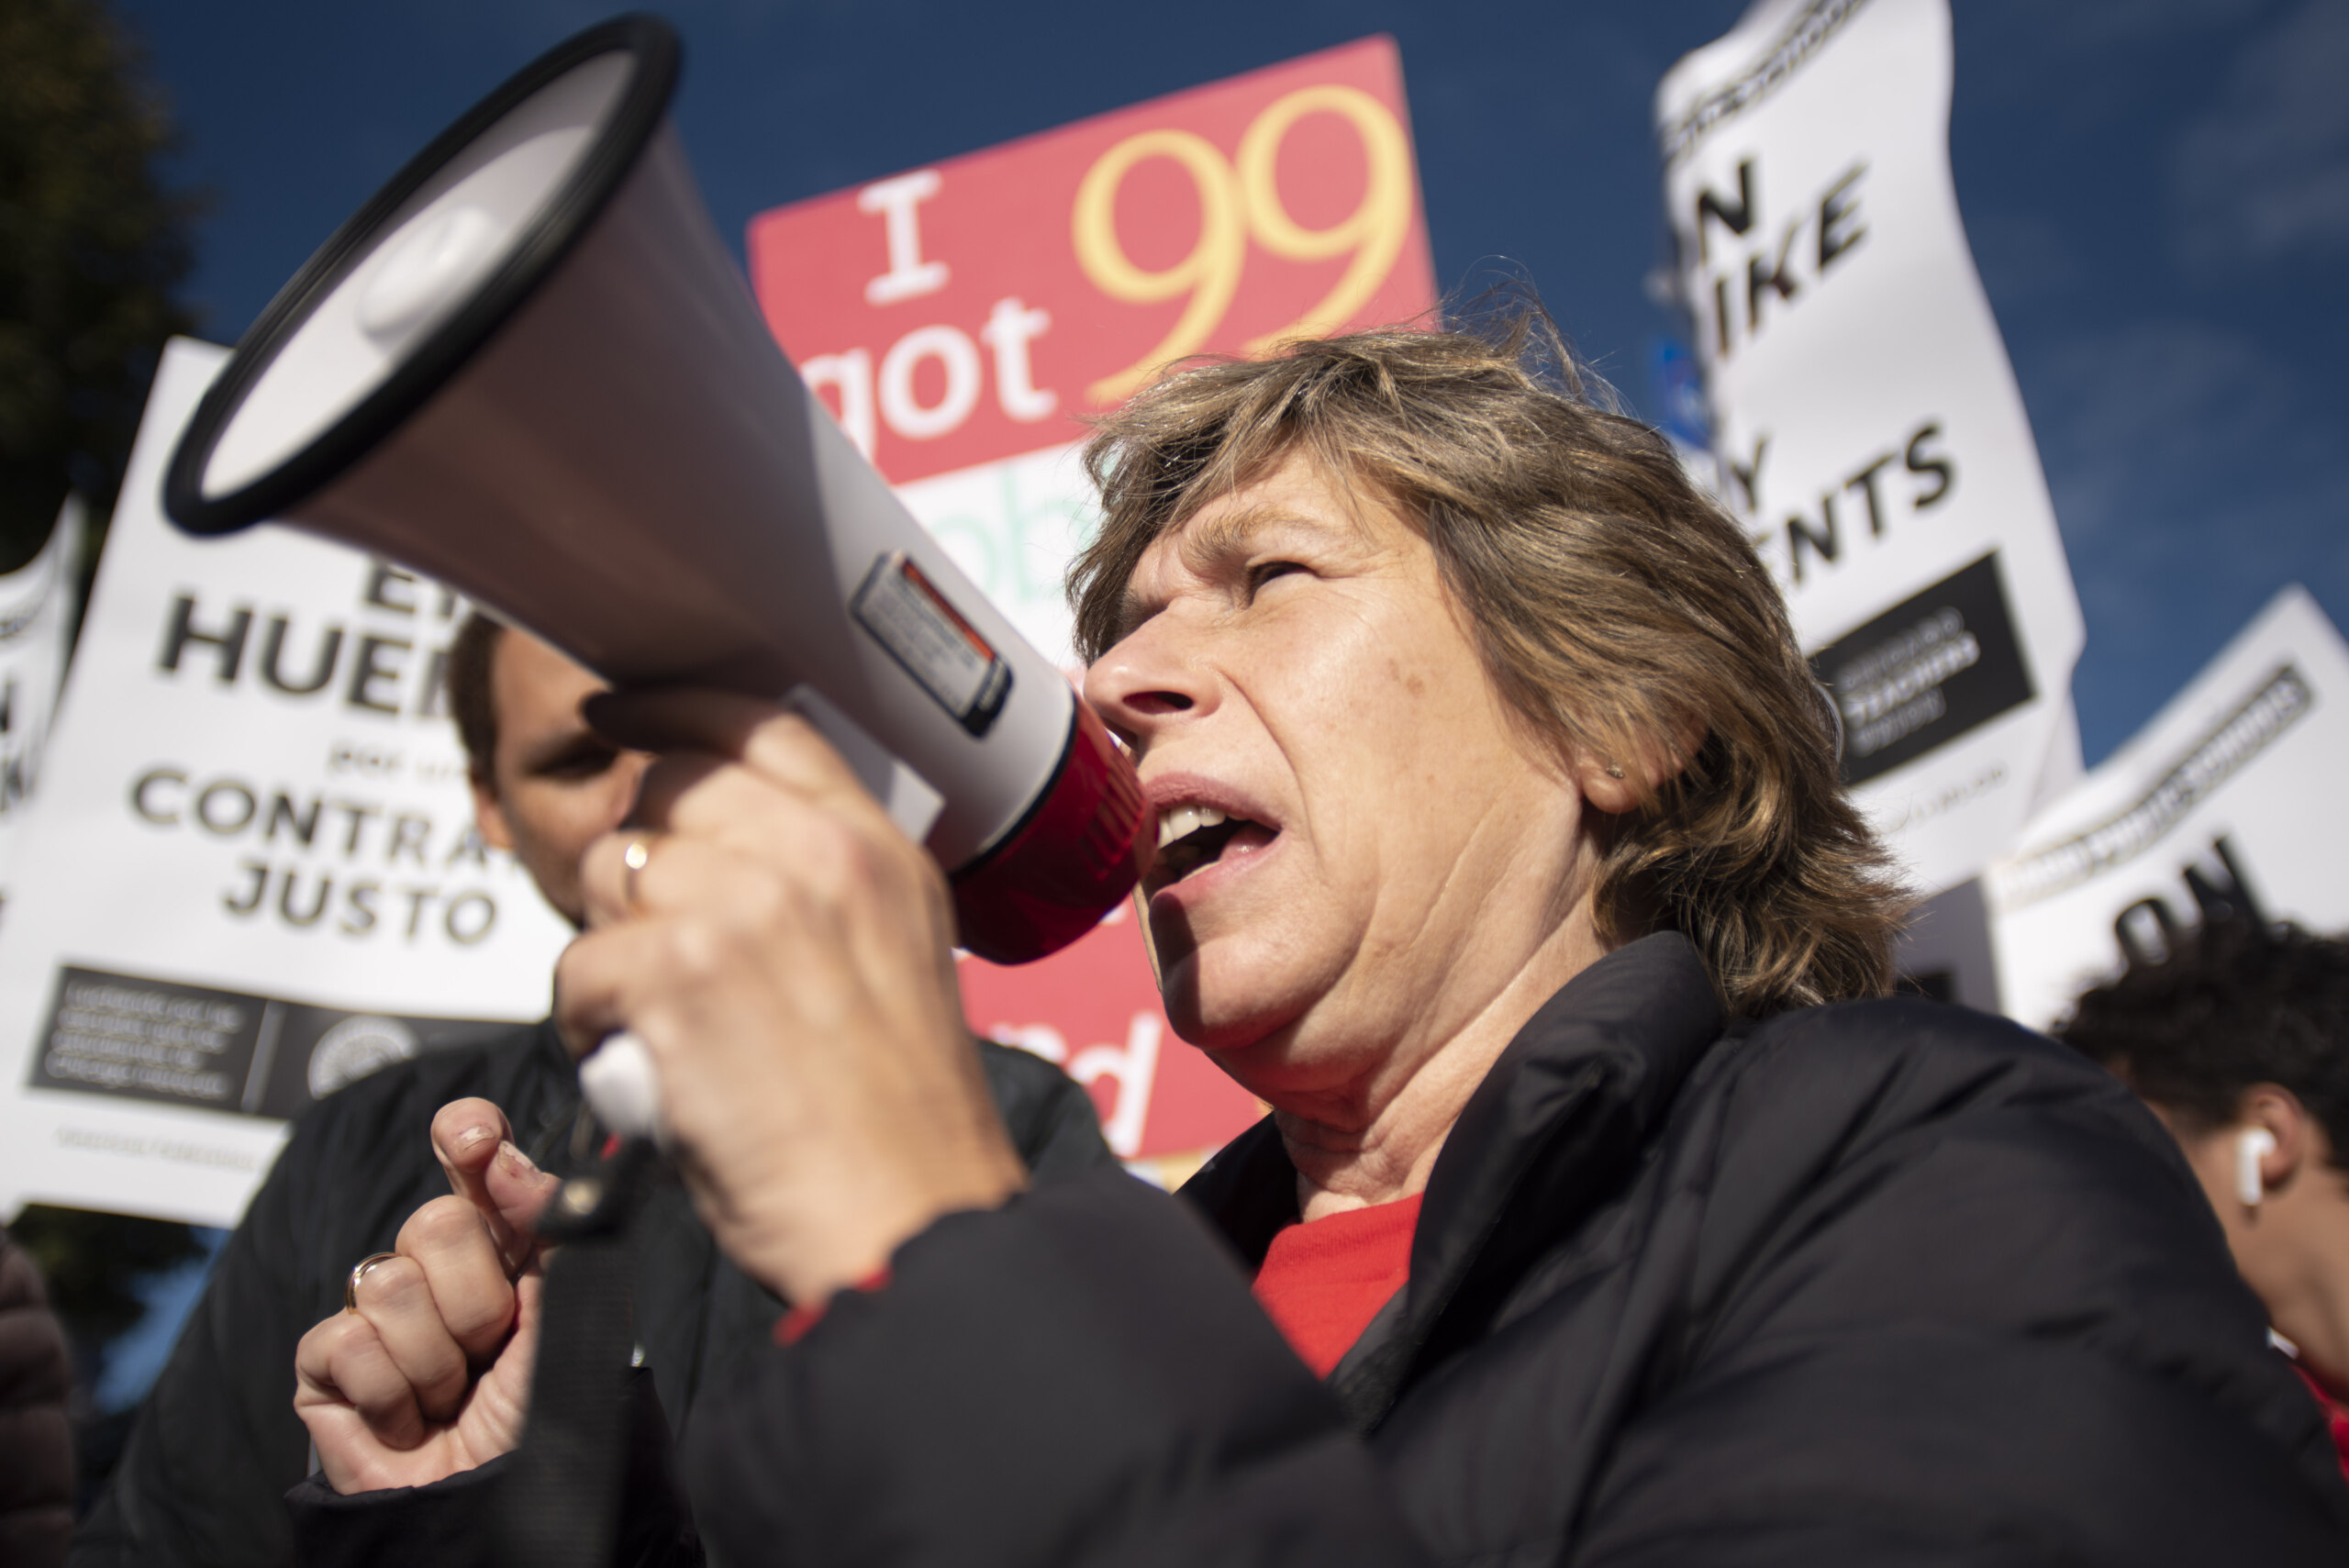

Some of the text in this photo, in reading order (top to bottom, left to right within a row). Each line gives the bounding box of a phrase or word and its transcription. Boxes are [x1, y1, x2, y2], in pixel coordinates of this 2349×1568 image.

[1072, 84, 1413, 407] 99
[1771, 420, 1956, 585] NTS
[128, 763, 500, 870] CONTRA
[222, 859, 498, 945] JUSTO
